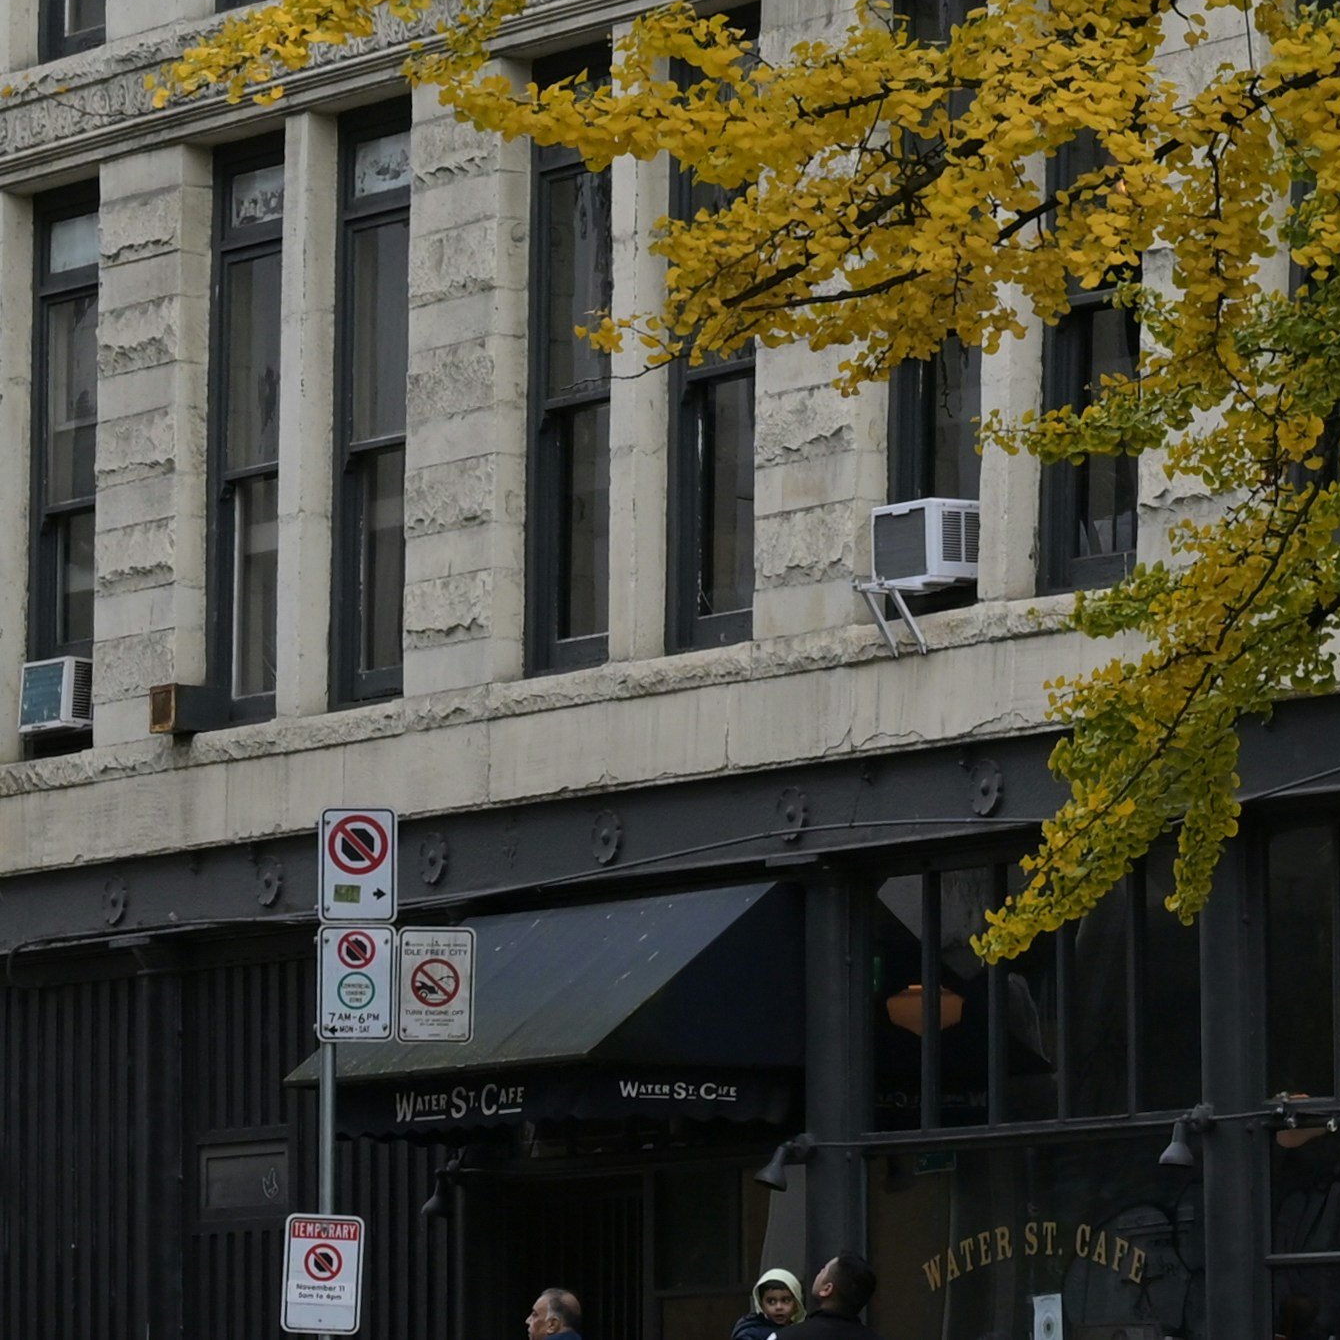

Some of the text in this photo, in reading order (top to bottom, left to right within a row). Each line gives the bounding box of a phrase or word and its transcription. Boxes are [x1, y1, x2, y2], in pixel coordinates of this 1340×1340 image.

[294, 1222, 356, 1239] TEMPORARY
[921, 1221, 1146, 1292] WATER ST. CAFE
[296, 1283, 336, 1292] November
